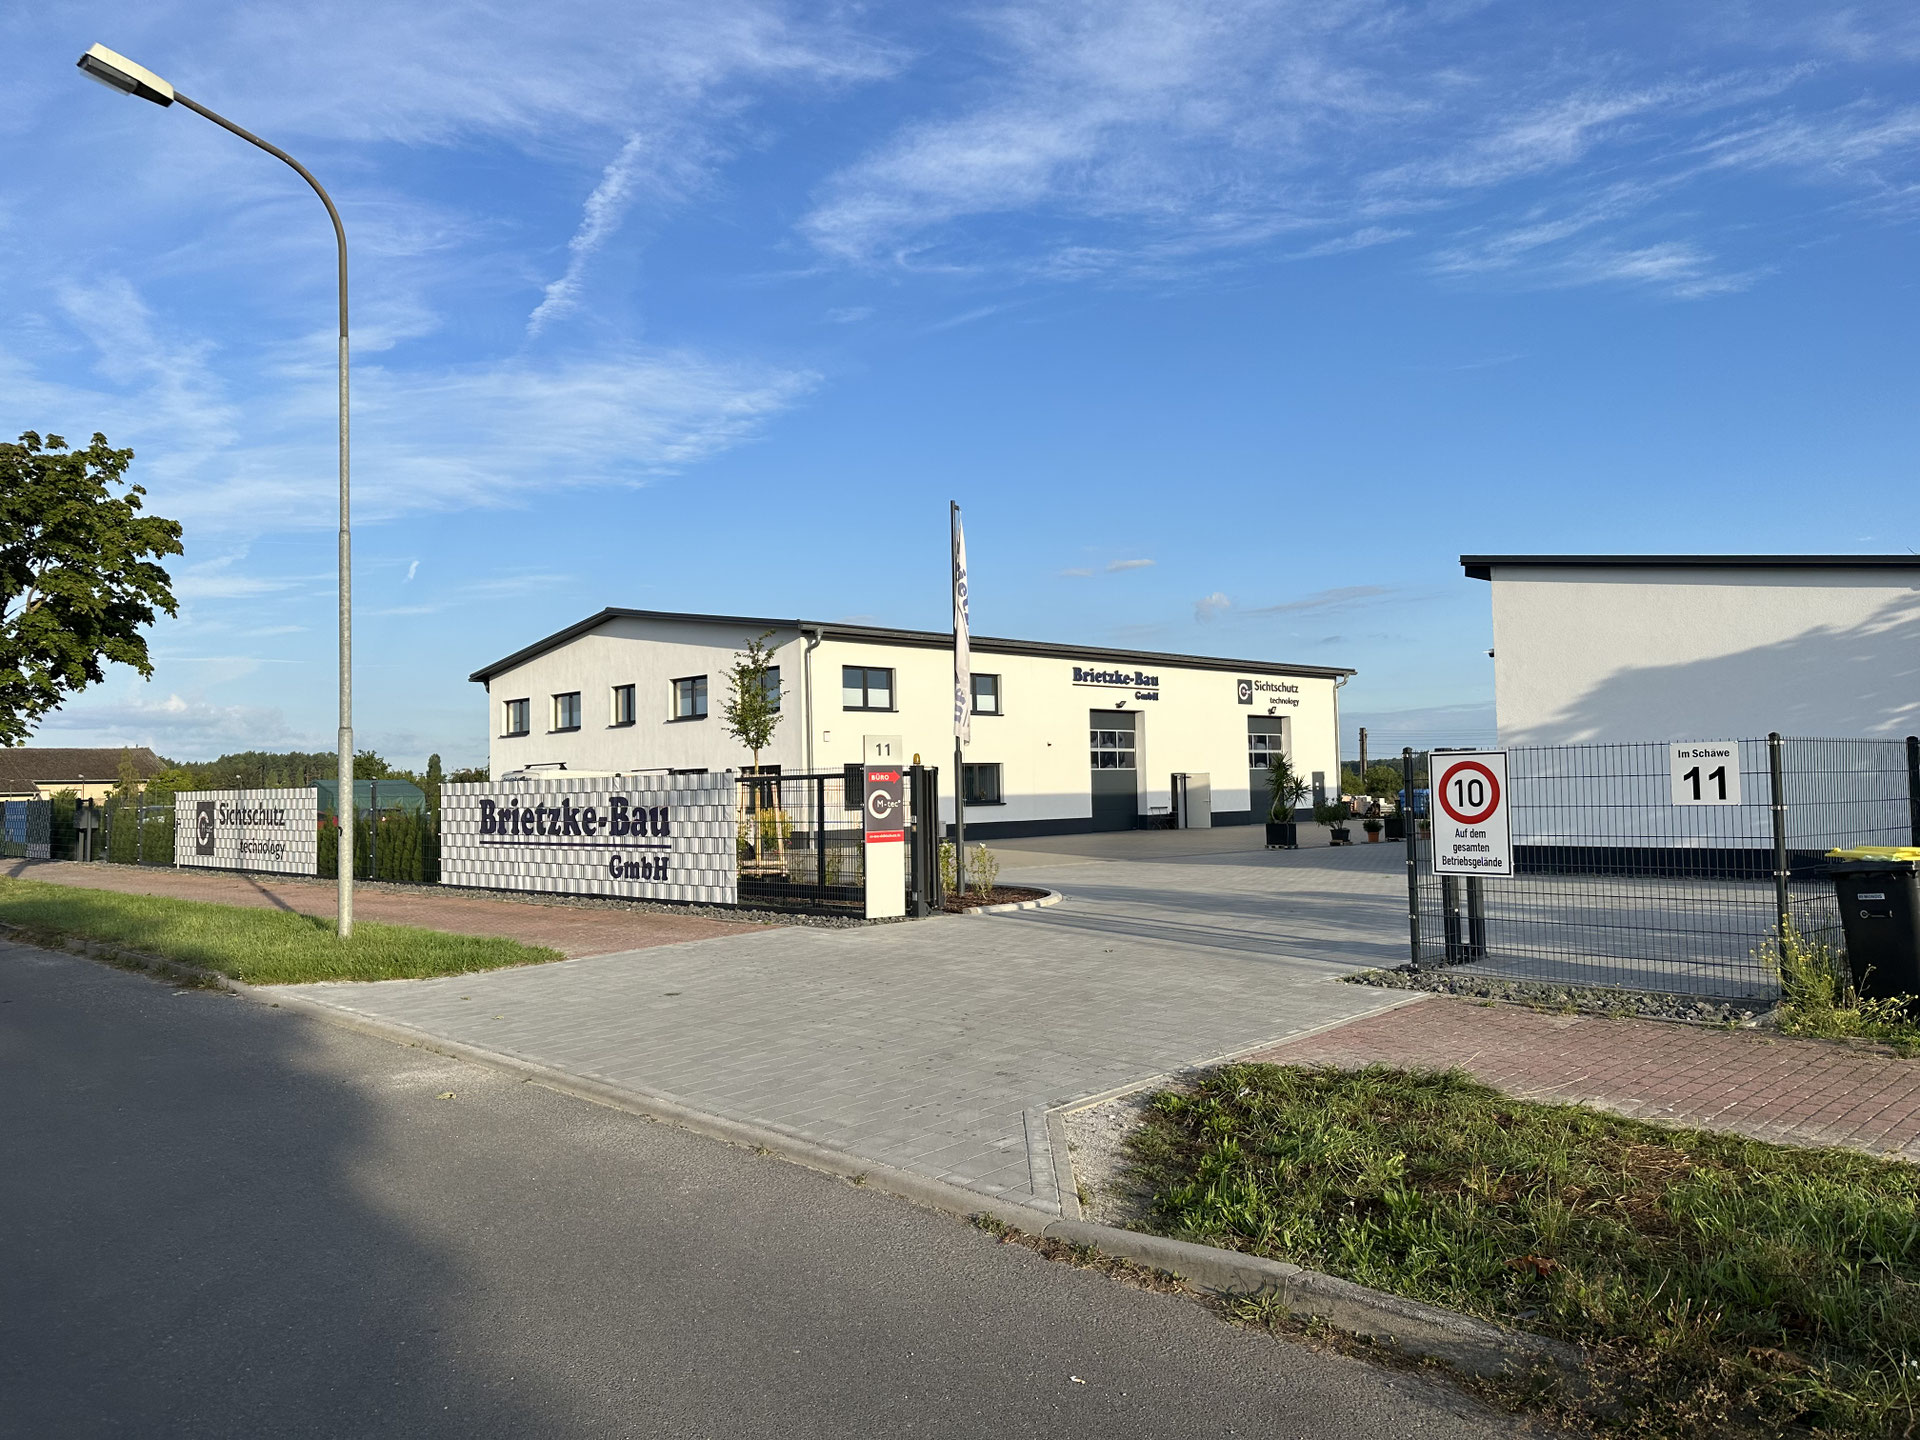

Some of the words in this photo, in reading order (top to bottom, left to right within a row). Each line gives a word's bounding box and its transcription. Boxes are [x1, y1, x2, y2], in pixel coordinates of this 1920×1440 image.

[1072, 667, 1159, 686] Brietzke-Bau
[1254, 679, 1299, 693] Sichtschutz
[1269, 697, 1300, 707] technology
[875, 743, 891, 756] 11
[1678, 749, 1690, 759] Im
[1692, 748, 1730, 758] Schäwe
[871, 773, 890, 781] BÜRO
[1683, 765, 1727, 800] 11
[1454, 778, 1484, 807] 10
[218, 802, 286, 827] Sichtschutz
[479, 796, 671, 837] Brietzke-Bau
[1454, 828, 1468, 839] Auf
[1469, 828, 1486, 839] dem
[239, 838, 286, 860] technology
[1452, 843, 1490, 854] gesamten
[609, 854, 670, 881] GmbH
[1442, 855, 1502, 869] Betriebsgelände
